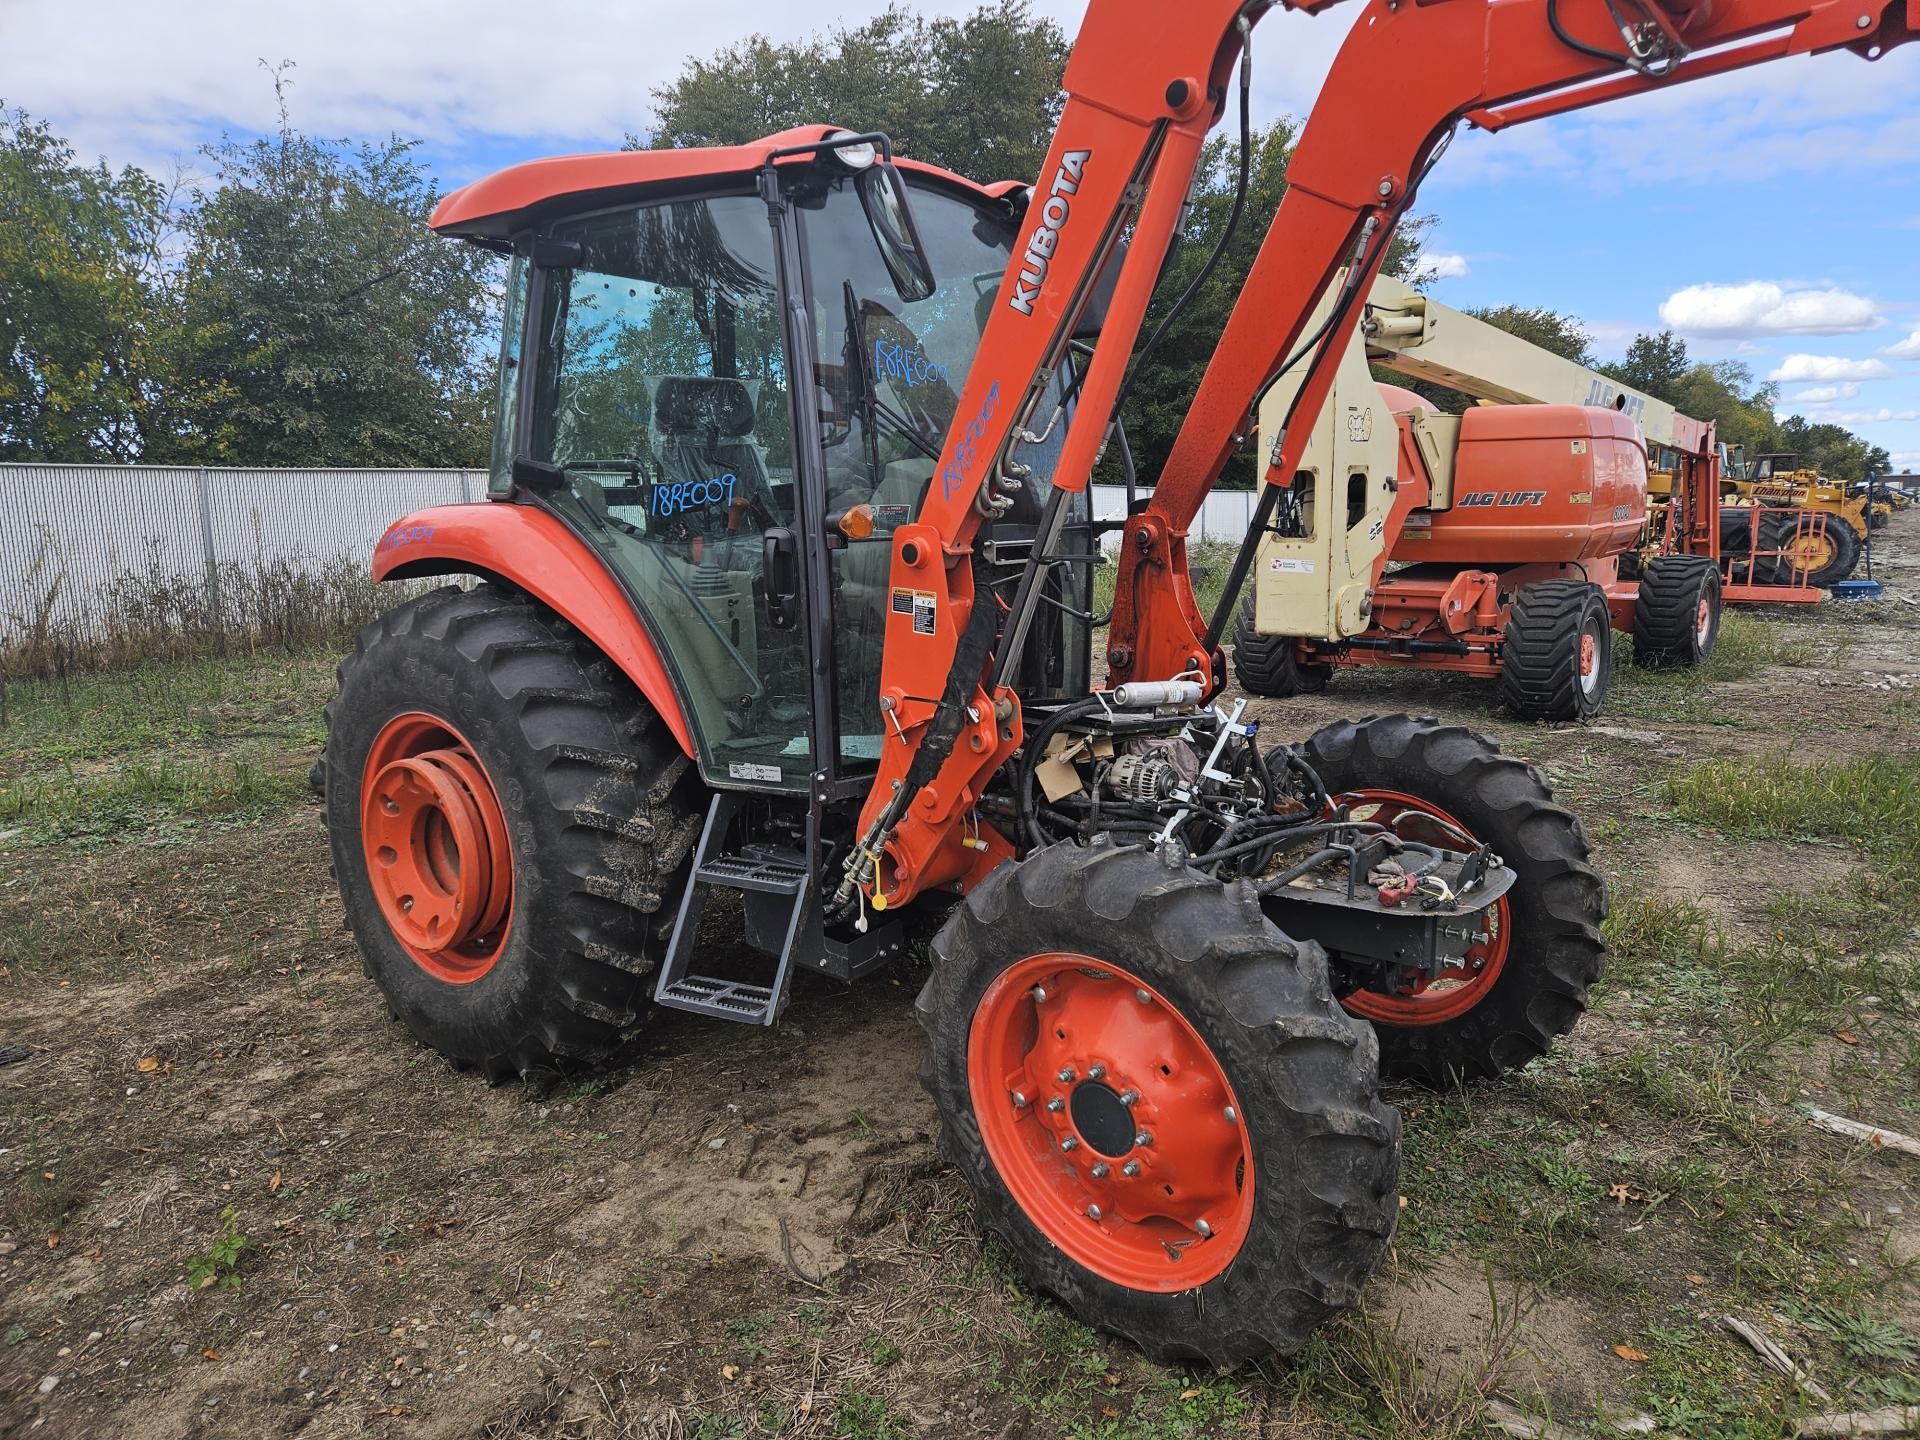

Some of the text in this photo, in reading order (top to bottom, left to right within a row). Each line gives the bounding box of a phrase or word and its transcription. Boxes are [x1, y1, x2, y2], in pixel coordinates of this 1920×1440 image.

[1009, 149, 1092, 317] KUBOTA
[1584, 379, 1646, 424] JLG IFT
[652, 473, 737, 517] 18RE009
[1457, 491, 1547, 507] JLG LIFT
[1753, 486, 1806, 497] Champon
